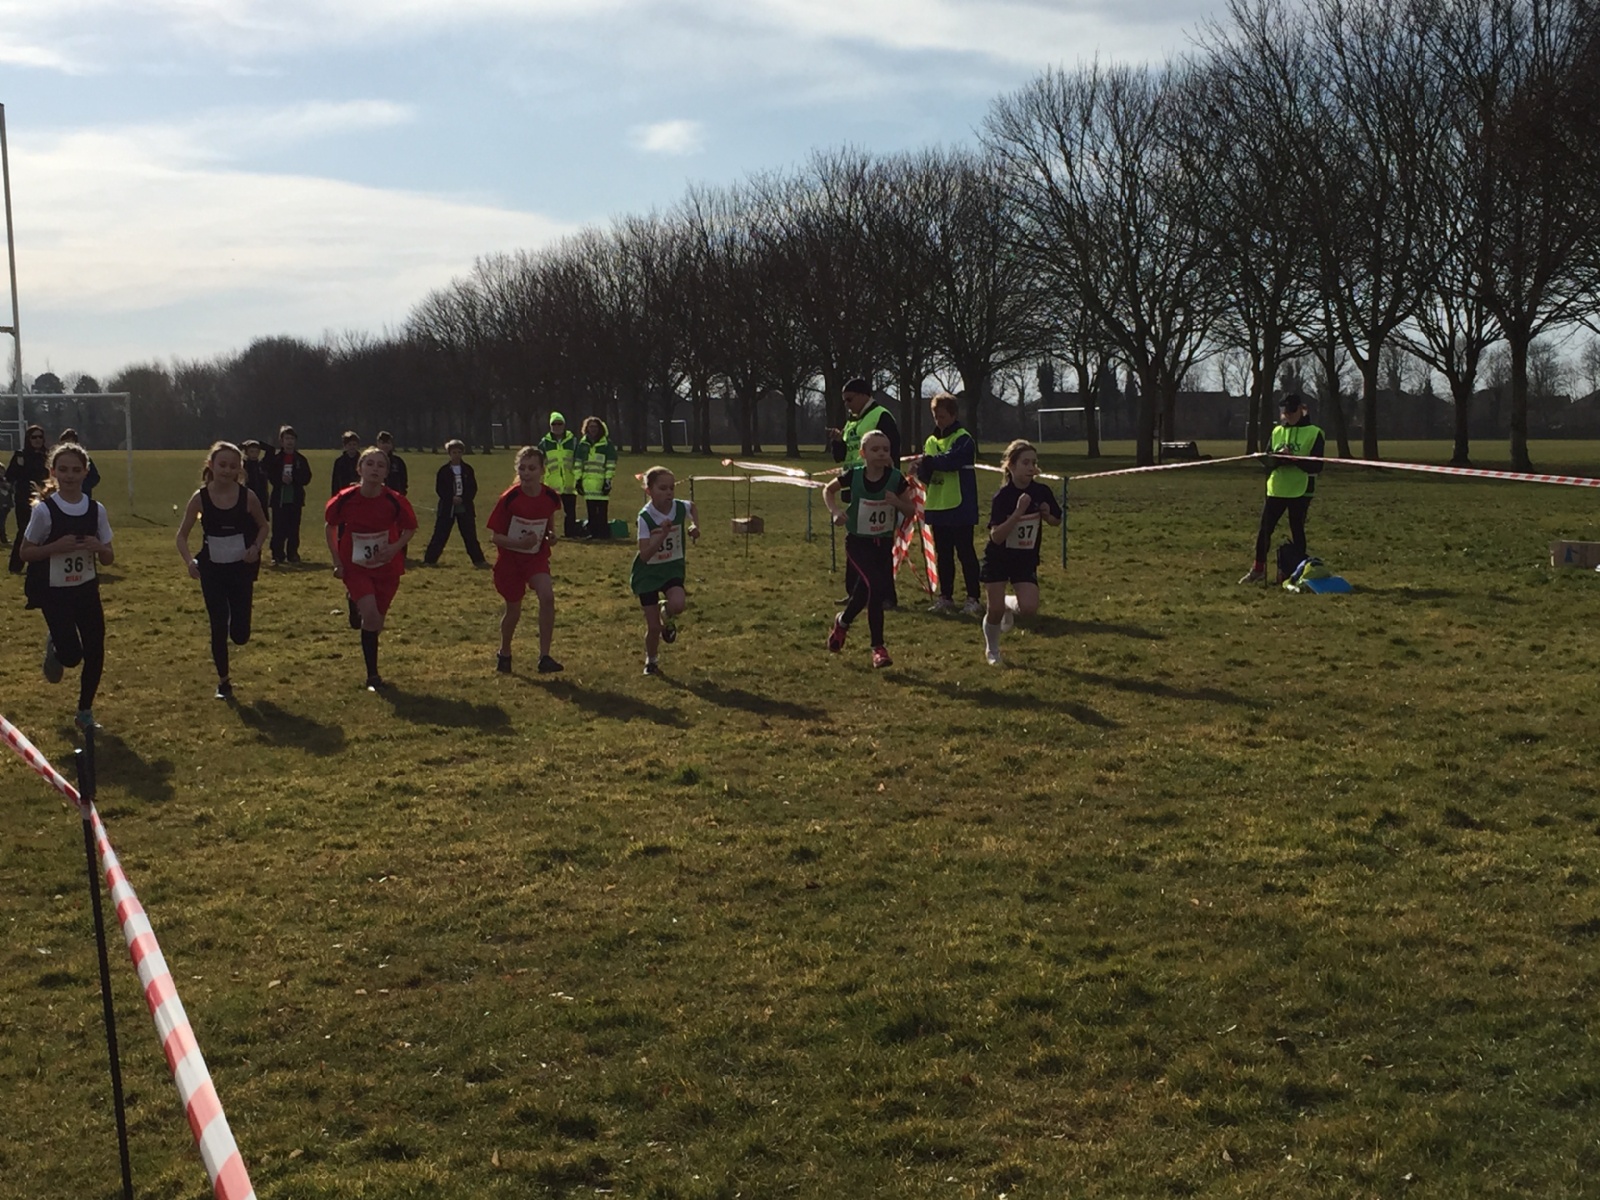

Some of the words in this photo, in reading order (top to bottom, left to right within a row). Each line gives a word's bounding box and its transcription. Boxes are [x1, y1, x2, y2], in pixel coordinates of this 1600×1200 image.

[869, 511, 886, 525] 40
[1018, 525, 1034, 539] 37
[64, 556, 84, 573] 36
